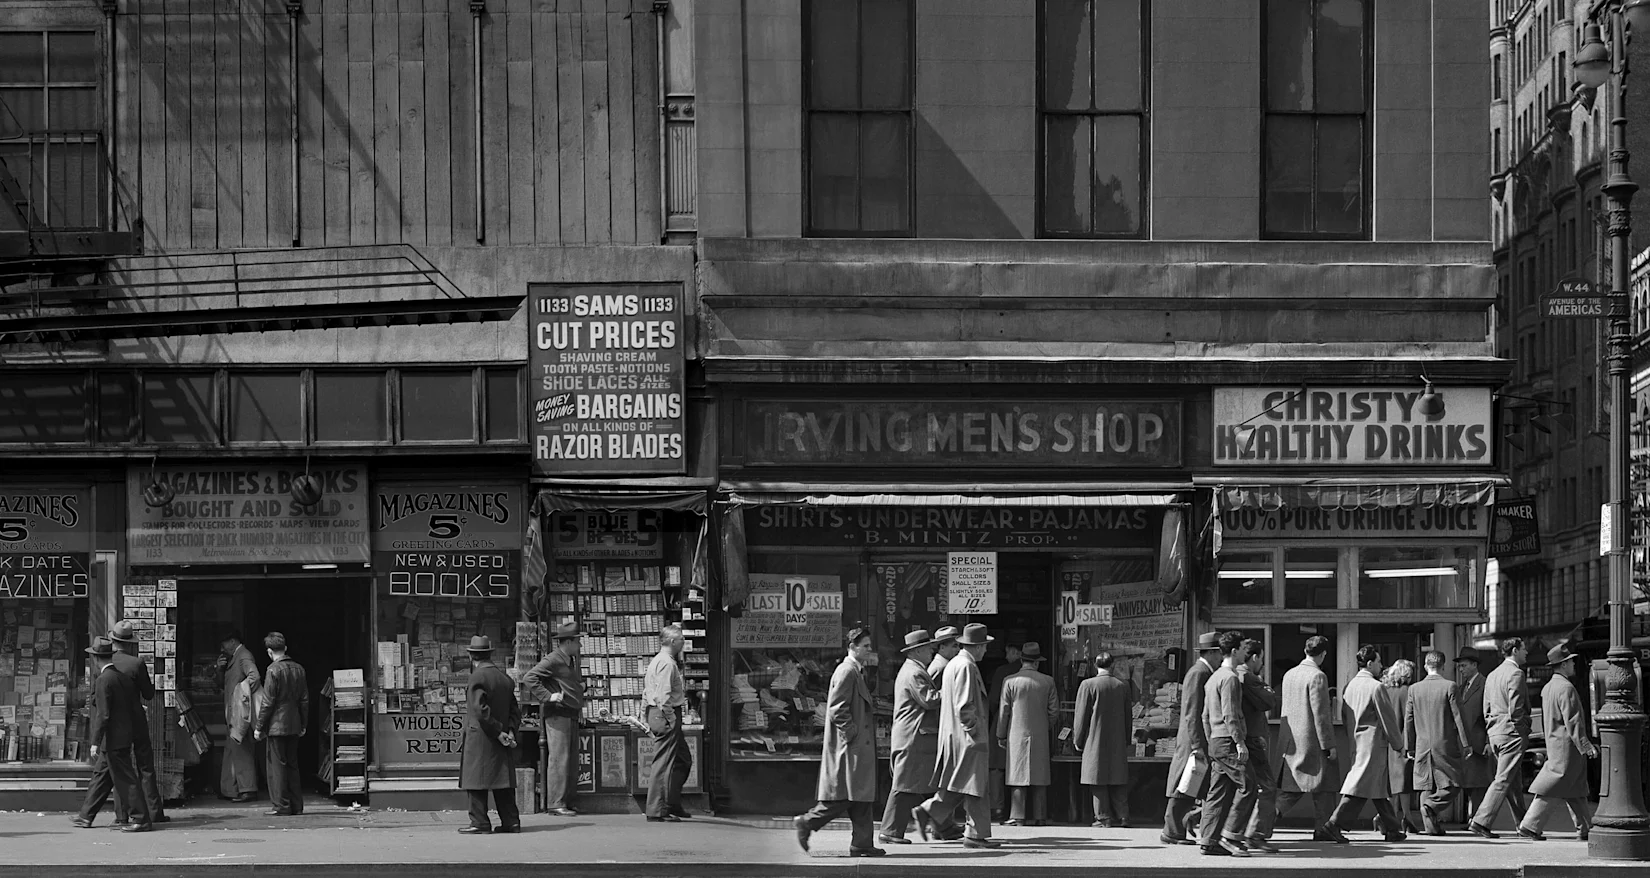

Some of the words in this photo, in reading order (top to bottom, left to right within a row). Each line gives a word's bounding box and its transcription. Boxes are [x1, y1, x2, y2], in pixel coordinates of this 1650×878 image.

[1574, 283, 1591, 293] 44
[541, 298, 569, 313] 1133
[574, 295, 639, 316] SAMS
[644, 297, 673, 312] 1133
[1548, 305, 1602, 315] AMERICAS
[537, 322, 582, 349] CUT
[590, 320, 676, 349] PRICES
[560, 352, 612, 362] SHAVING
[616, 352, 657, 361] CREAM
[543, 364, 578, 374] TOOTH
[581, 364, 615, 373] PASTE
[620, 364, 671, 373] NOTIONS
[543, 376, 584, 390] SHOE
[588, 375, 638, 389] LACES
[643, 375, 667, 383] ALL
[535, 393, 571, 412] MONEY
[577, 393, 681, 419] BARGAINS
[536, 404, 575, 423] SAVING
[563, 423, 579, 432] ON
[581, 423, 602, 432] ALL
[604, 422, 636, 432] KINDS
[640, 422, 653, 431] OF
[764, 411, 913, 452] IRVING
[927, 406, 1041, 452] MEN'S
[1052, 412, 1164, 452] SHOP
[537, 434, 602, 459] RAZOR
[608, 434, 682, 459] BLADES
[1365, 424, 1487, 460] DRINKS
[264, 476, 274, 494] &
[162, 500, 233, 519] BOUGHT
[240, 499, 281, 517] AND
[289, 499, 341, 517] SOLD
[378, 491, 510, 531] MAGAZINES
[142, 521, 169, 530] STAMPS
[171, 521, 186, 530] FOR
[187, 520, 236, 530] COLLECTORS
[239, 520, 273, 529] RECORDS
[280, 520, 303, 528] MAPS
[309, 520, 329, 528] VIEW
[332, 519, 360, 528] CARDS
[588, 515, 629, 529] BLUE
[759, 506, 844, 528] SHIRTS
[857, 507, 1015, 529] UNDERWEAR
[1029, 507, 1147, 530] PAJAMAS
[1280, 509, 1331, 531] PURE
[1337, 507, 1415, 531] ORANGE
[1420, 505, 1477, 531] JUICE
[559, 515, 580, 543] 5
[164, 533, 204, 548] SELECTION
[206, 533, 215, 547] OF
[276, 532, 321, 546] MAGAZINES
[392, 540, 452, 549] GREETING
[456, 540, 495, 548] CARDS
[866, 531, 888, 543] B.
[899, 531, 991, 544] MINTZ
[1005, 535, 1059, 545] PROP.
[23, 542, 62, 550] CARDS
[146, 549, 162, 558] 1133
[333, 547, 349, 556] 1133
[22, 556, 72, 568] DATE
[395, 553, 431, 567] NEW
[436, 554, 447, 567] &
[452, 554, 504, 568] USED
[951, 556, 993, 565] SPECIAL
[389, 571, 510, 598] BOOKS
[751, 595, 782, 610] LAST
[786, 583, 806, 612] 10
[813, 595, 840, 610] SALE
[1062, 596, 1076, 625] 10
[1082, 607, 1110, 622] SALE
[1112, 598, 1162, 617] ANNIVERSARY
[786, 613, 806, 622] DAYS
[1062, 627, 1076, 636] DAYS
[603, 751, 610, 762] 3
